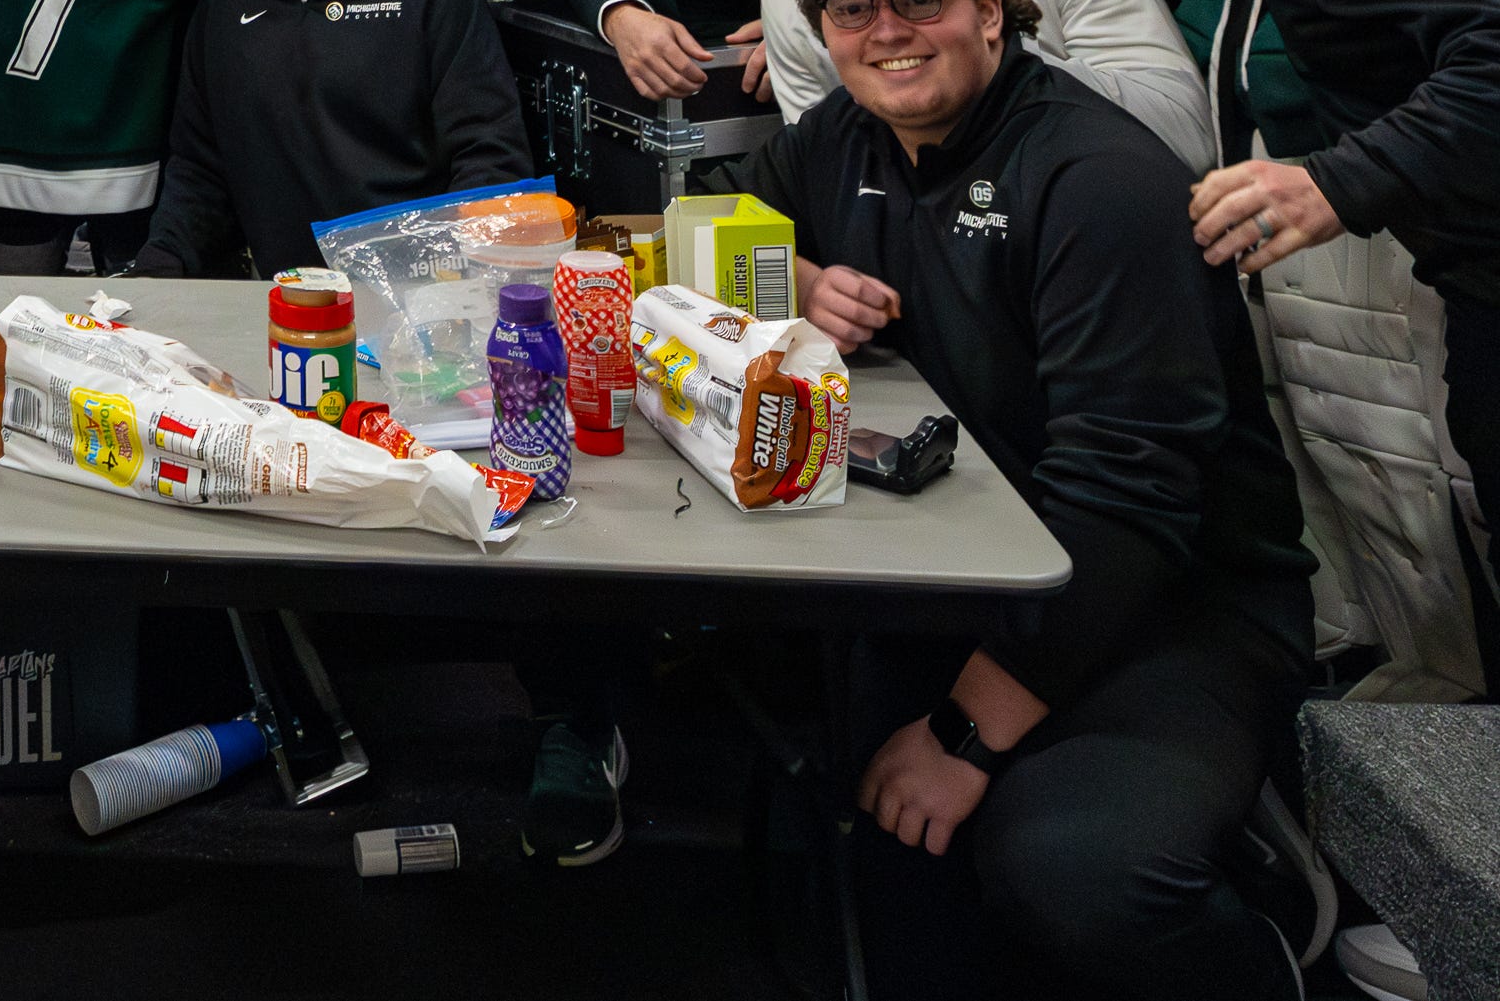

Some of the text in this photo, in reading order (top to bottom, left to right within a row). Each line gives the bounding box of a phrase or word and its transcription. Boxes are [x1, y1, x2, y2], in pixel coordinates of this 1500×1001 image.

[346, 2, 403, 13] MICHIGAN STATE
[973, 187, 993, 202] DS
[734, 254, 748, 299] JUICERS
[269, 347, 340, 408] Jif
[753, 391, 781, 468] White
[775, 395, 796, 472] Whole Grain
[495, 445, 554, 471] SMUCKER'S
